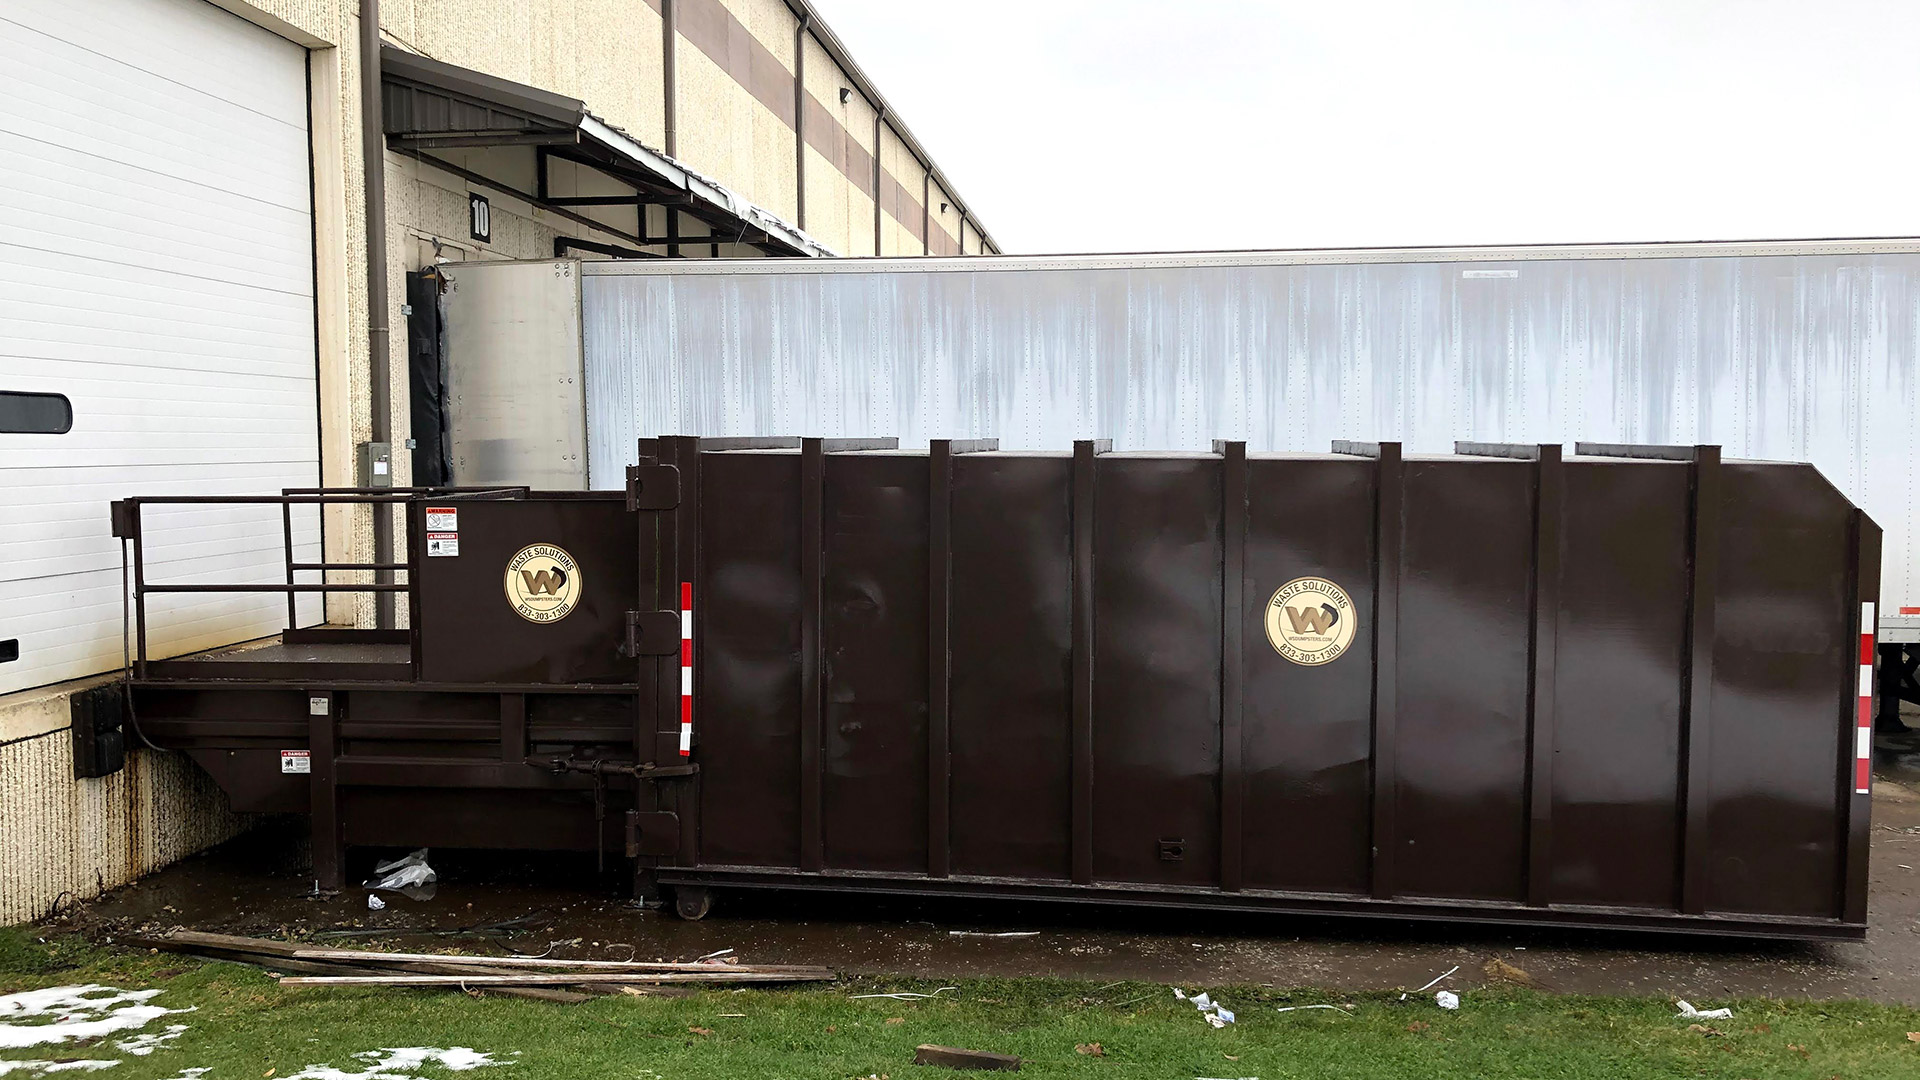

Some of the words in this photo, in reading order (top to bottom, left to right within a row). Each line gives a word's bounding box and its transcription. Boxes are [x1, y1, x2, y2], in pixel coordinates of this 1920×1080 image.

[472, 200, 488, 237] 10
[510, 549, 533, 572] WASTE
[534, 547, 575, 572] SOLUTIONS
[1273, 583, 1300, 608] WASTE
[1302, 581, 1349, 609] SOLUTIONS
[518, 603, 570, 620] 833-303-1300
[1280, 643, 1341, 662] 833-303-1300
